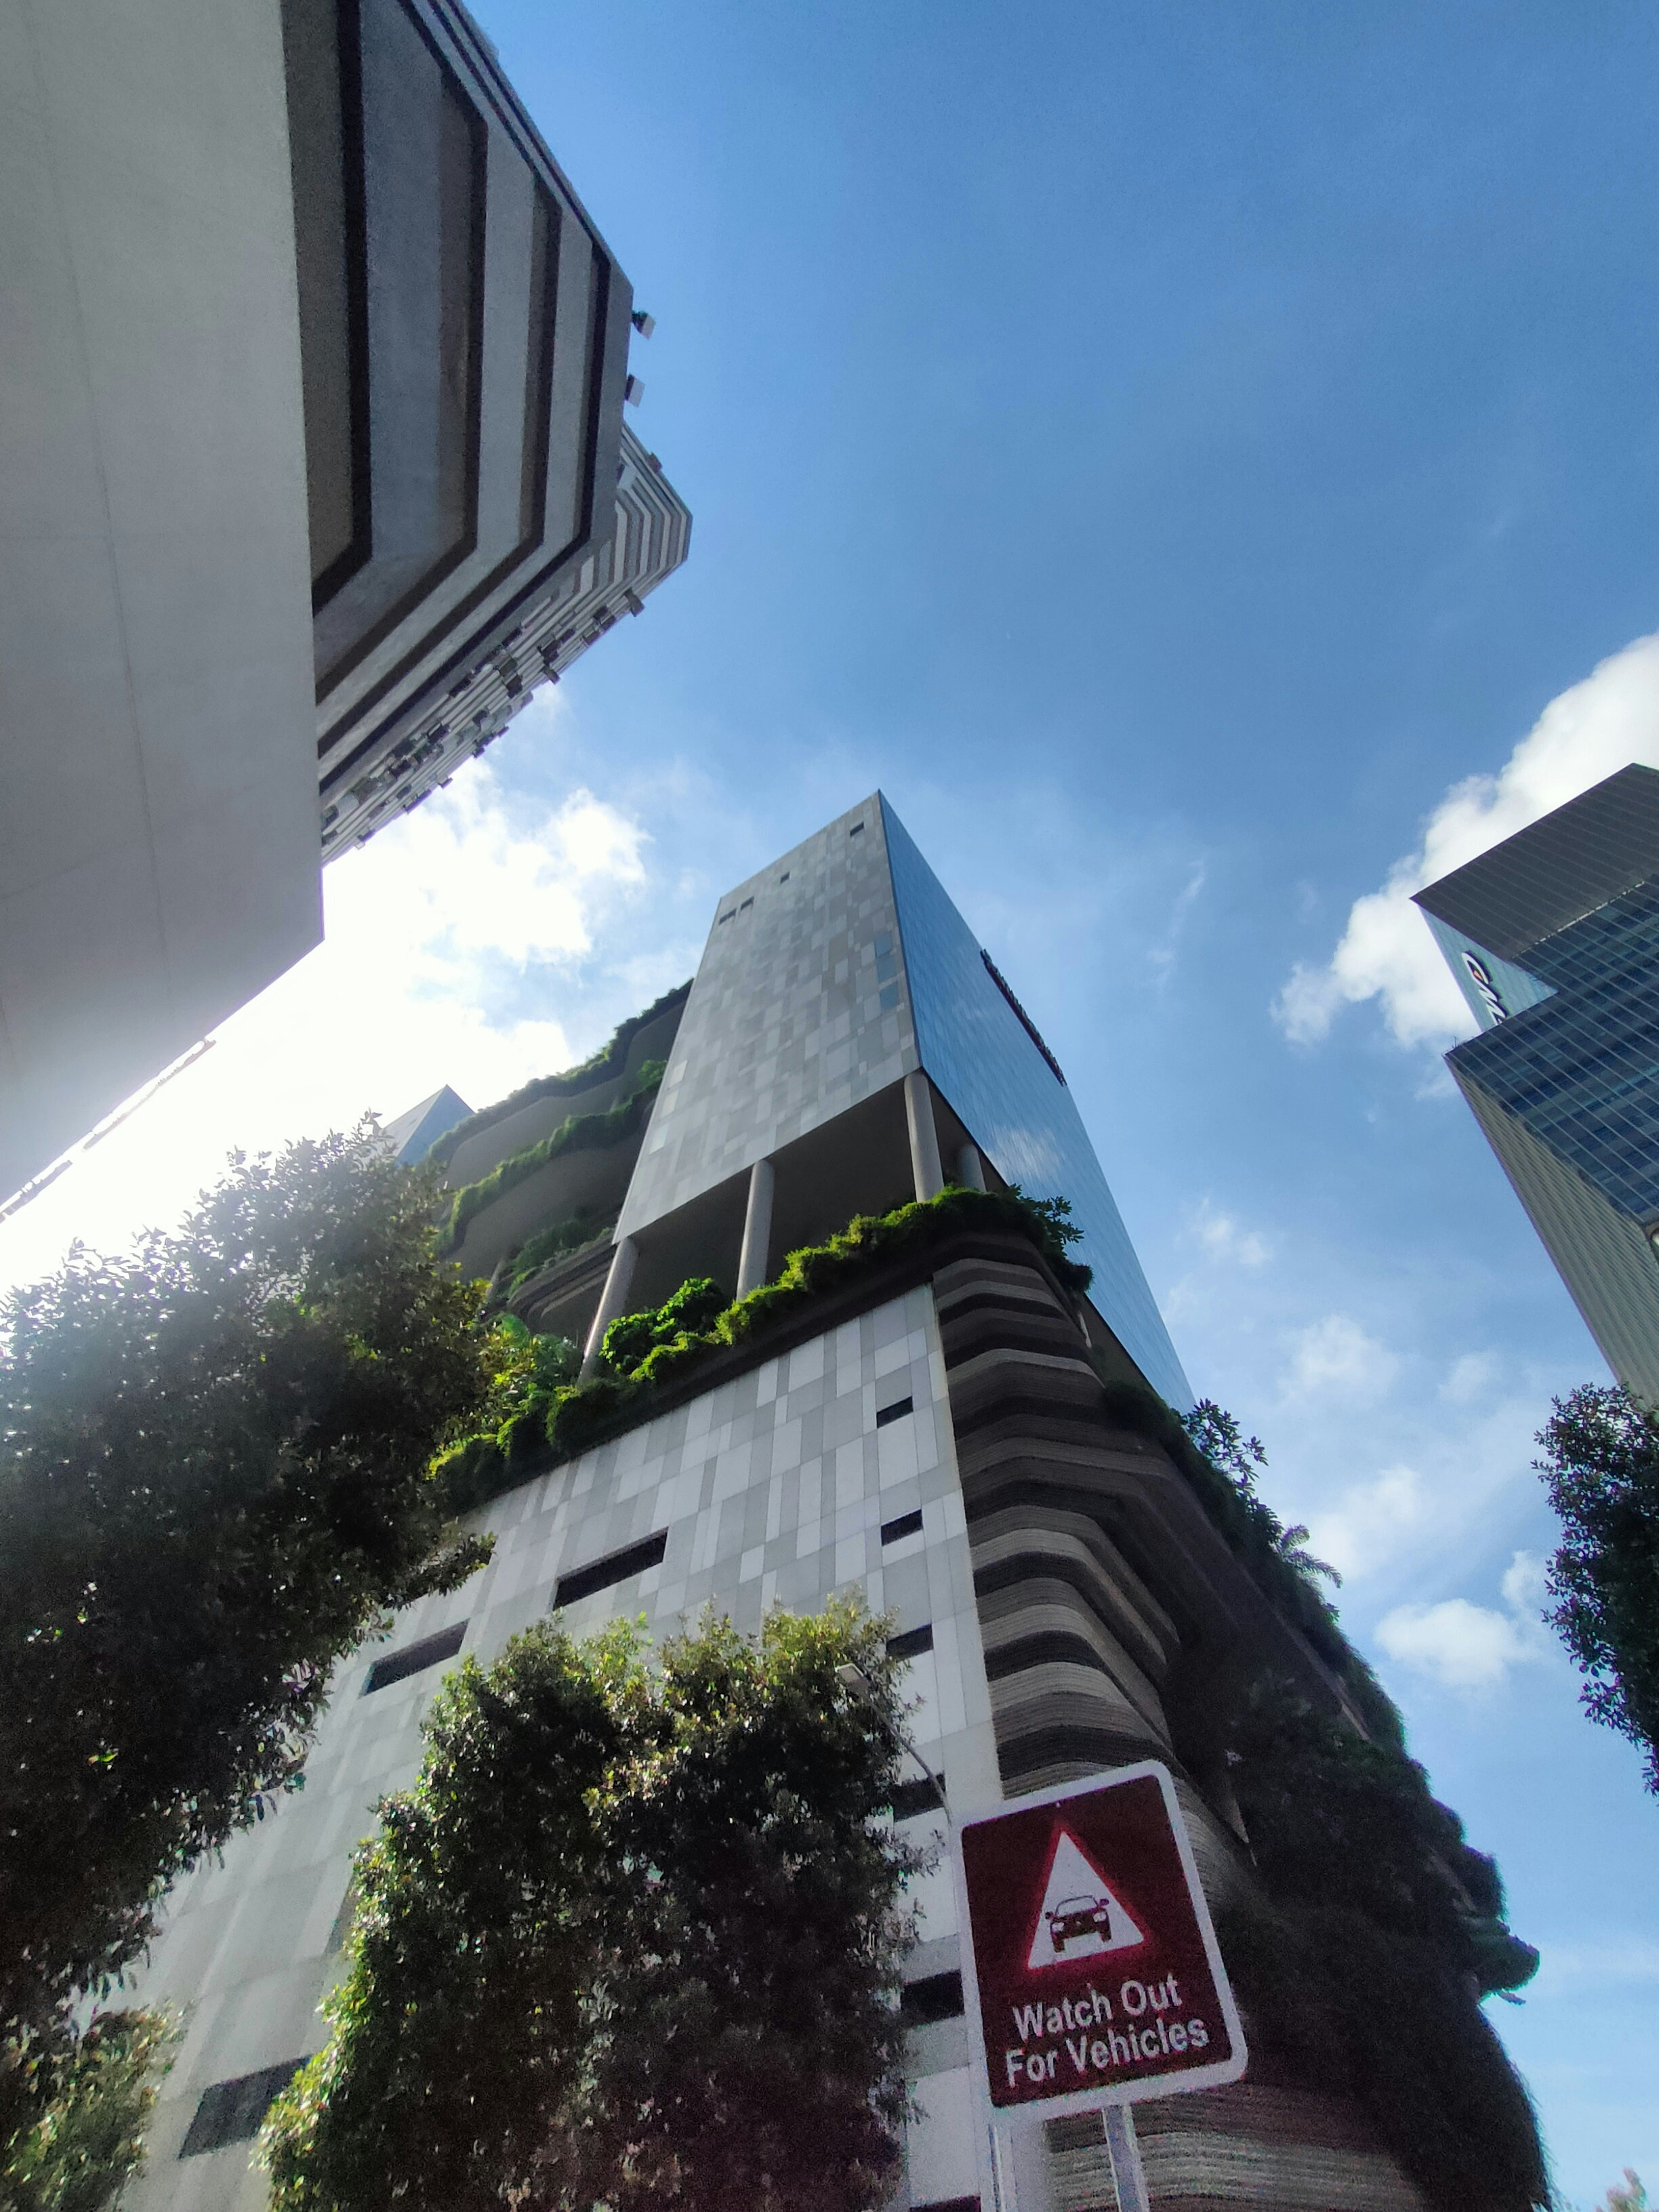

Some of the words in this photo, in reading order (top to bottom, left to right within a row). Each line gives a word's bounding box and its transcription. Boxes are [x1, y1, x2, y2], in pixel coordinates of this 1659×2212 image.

[1013, 1983, 1112, 2042] Watch
[1121, 1973, 1182, 2015] Out
[1005, 2048, 1058, 2088] For
[1065, 2016, 1208, 2074] Vehicles
